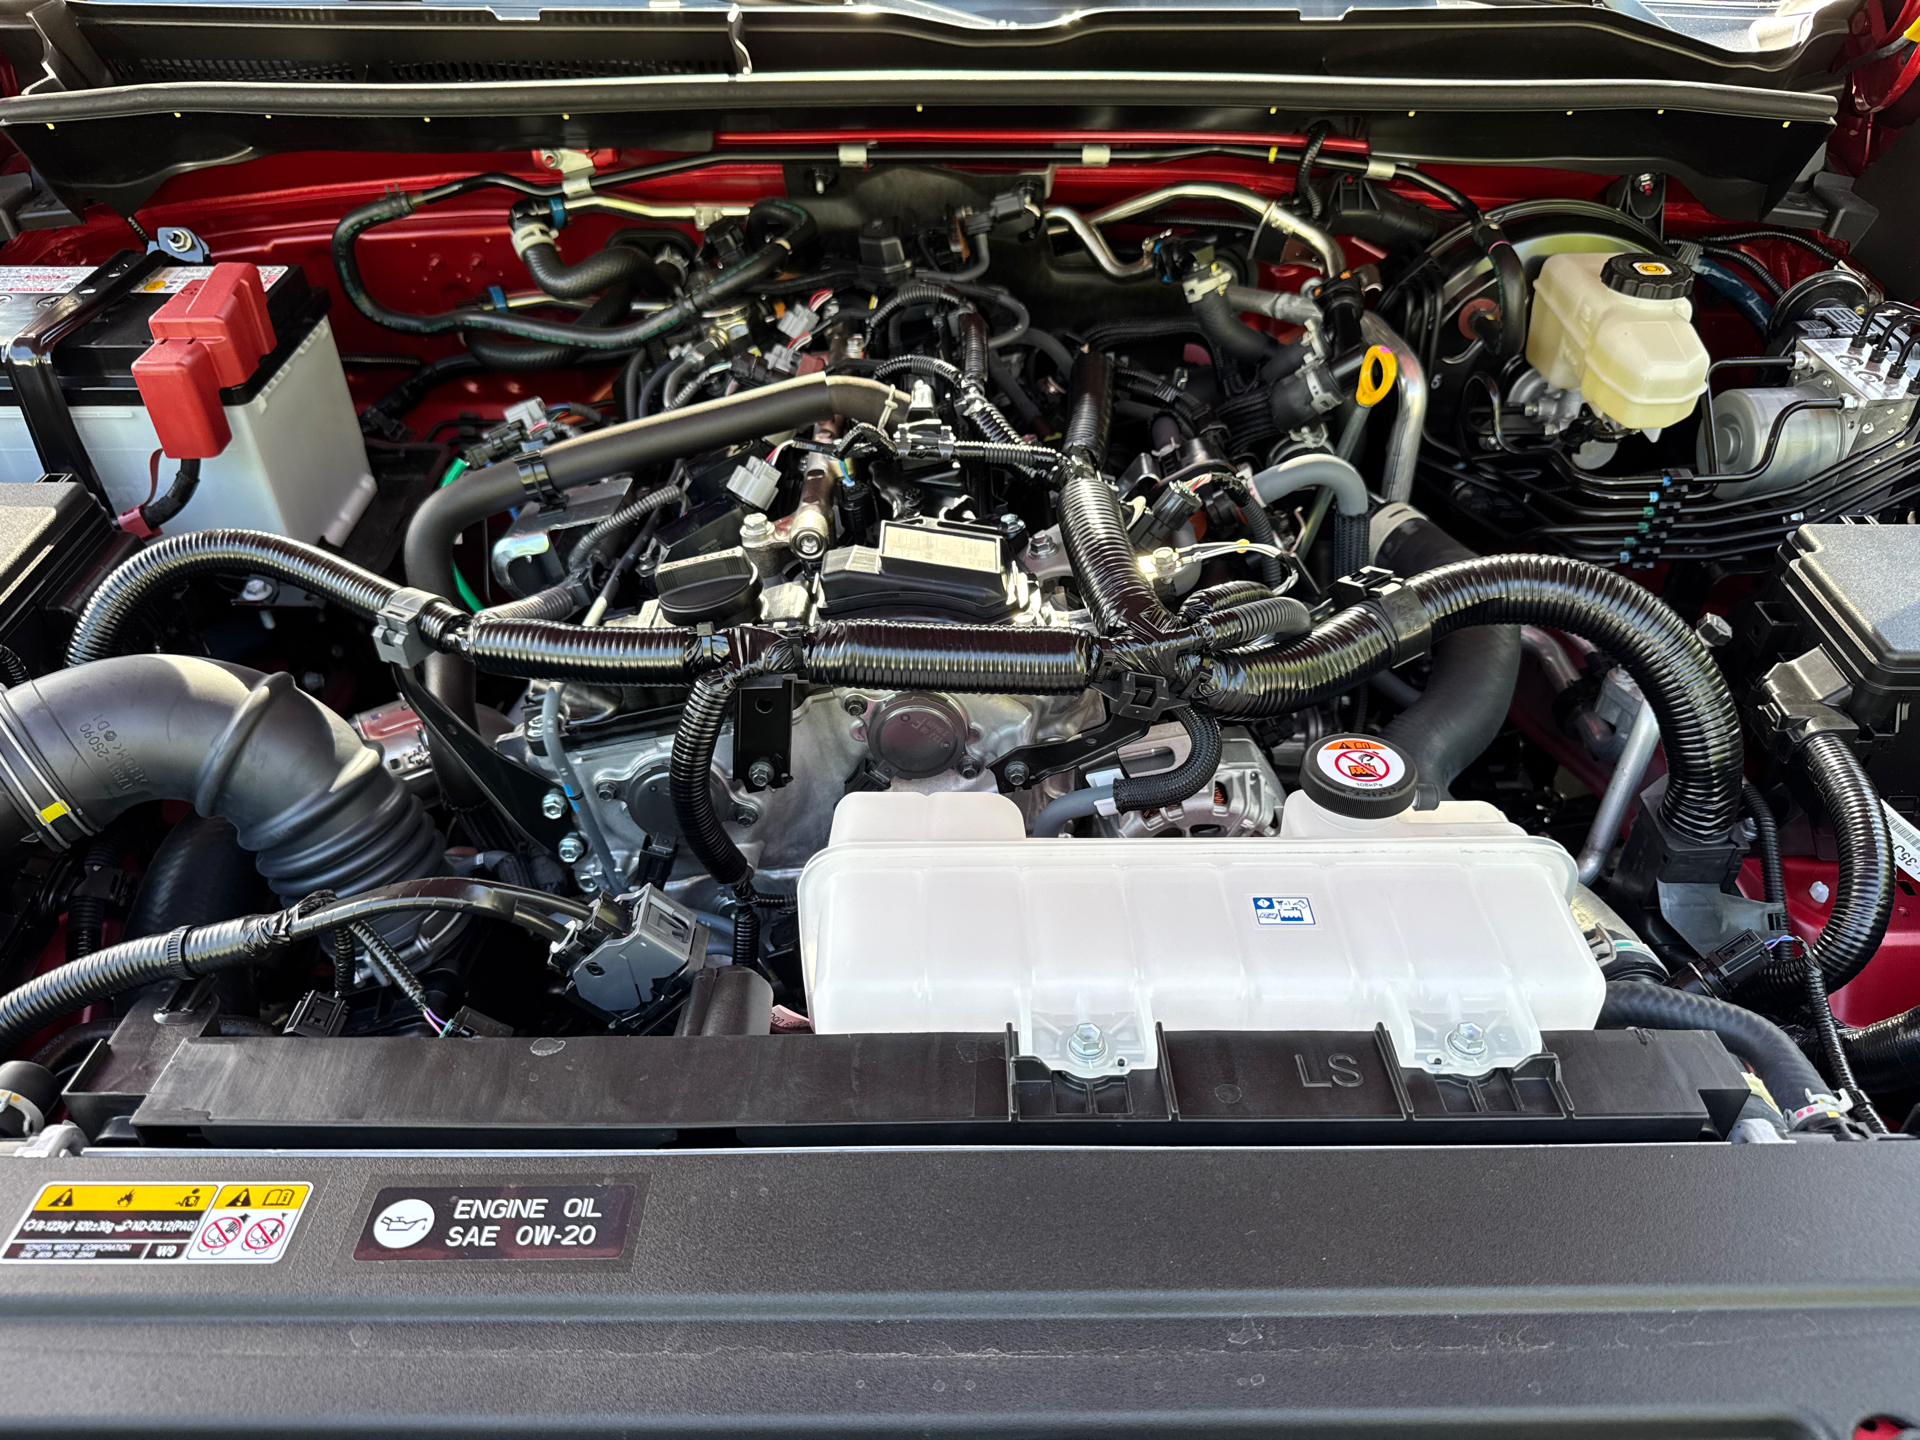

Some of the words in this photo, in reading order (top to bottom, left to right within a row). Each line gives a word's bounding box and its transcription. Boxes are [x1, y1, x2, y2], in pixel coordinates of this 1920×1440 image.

[1294, 1052, 1365, 1088] LS
[453, 1199, 549, 1220] ENGINE
[563, 1198, 602, 1218] OIL
[445, 1226, 501, 1247] SAE
[515, 1225, 597, 1246] 0W-20
[53, 1243, 81, 1252] MOTOR
[80, 1243, 133, 1252] CORPORATION
[156, 1245, 178, 1258] W9
